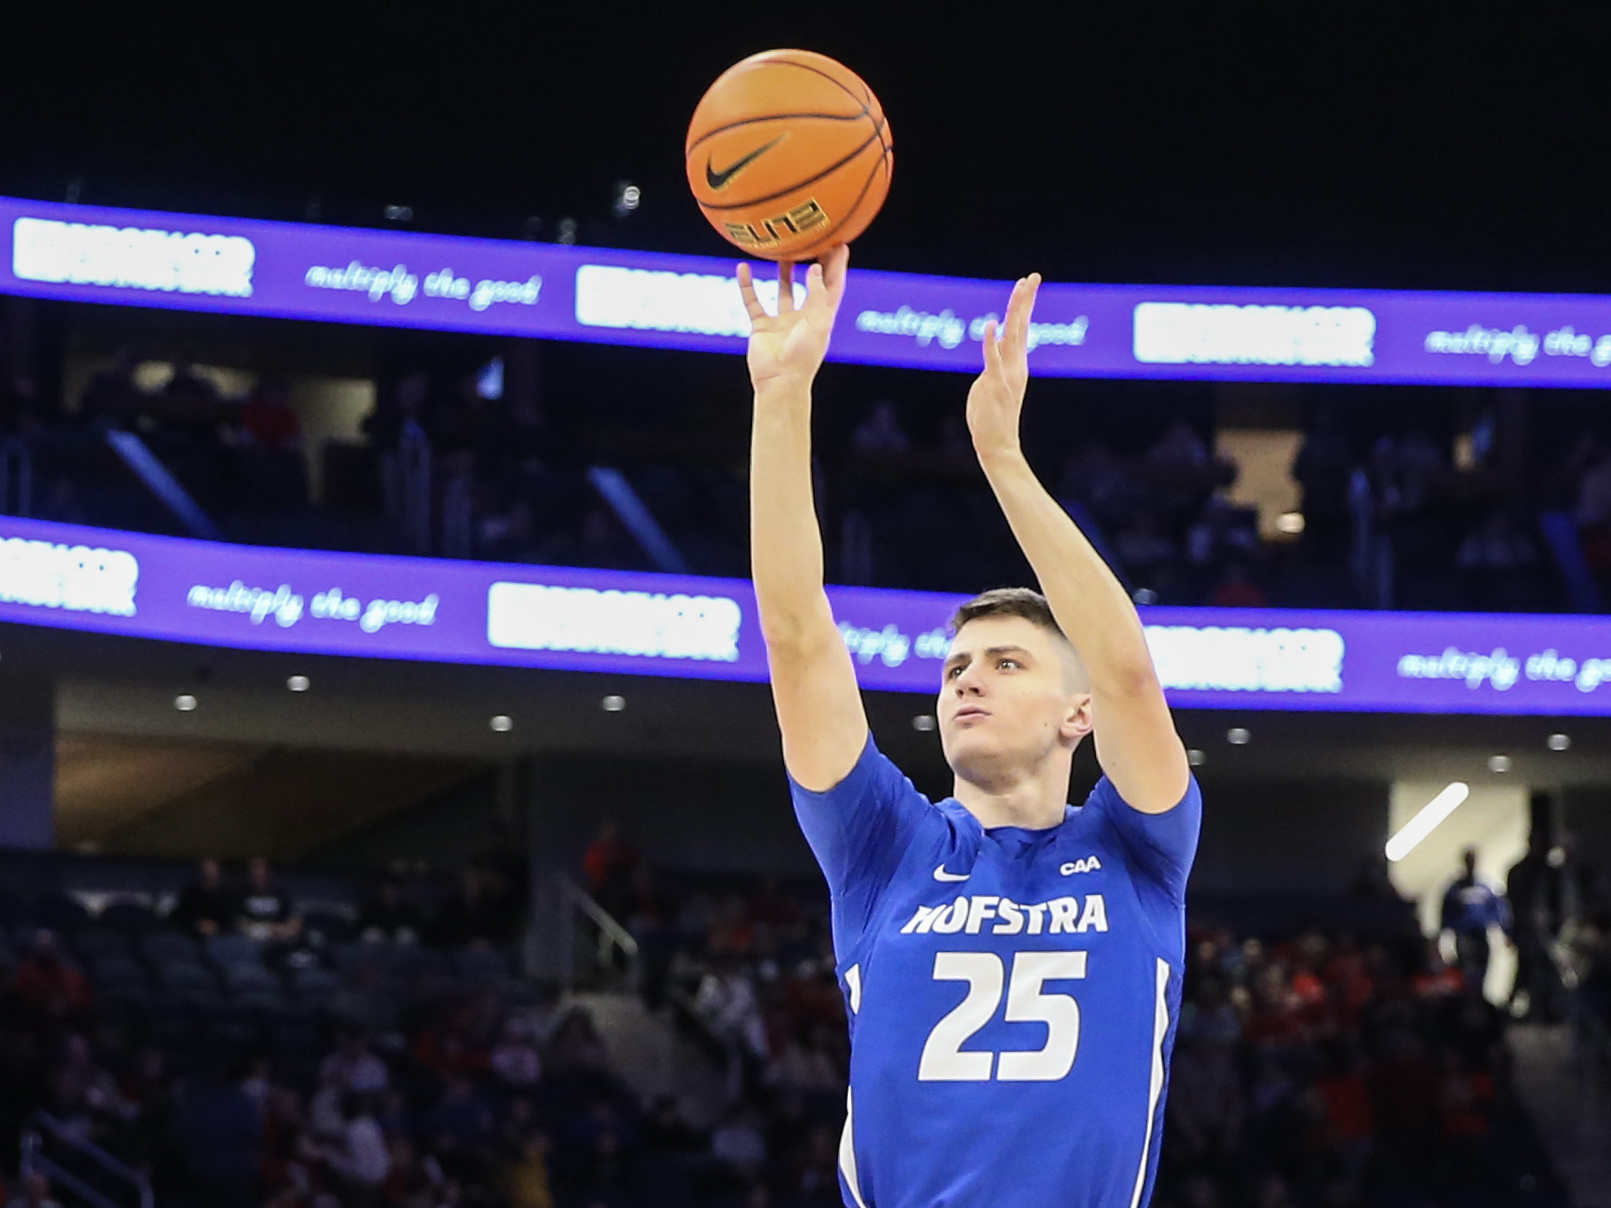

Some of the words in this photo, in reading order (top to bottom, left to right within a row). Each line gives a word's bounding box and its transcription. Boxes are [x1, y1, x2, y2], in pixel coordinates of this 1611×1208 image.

[423, 267, 471, 300] the
[310, 587, 361, 620] the
[1060, 855, 1101, 876] CAA
[900, 895, 1109, 934] HOFSTRA
[917, 951, 1087, 1081] 25
